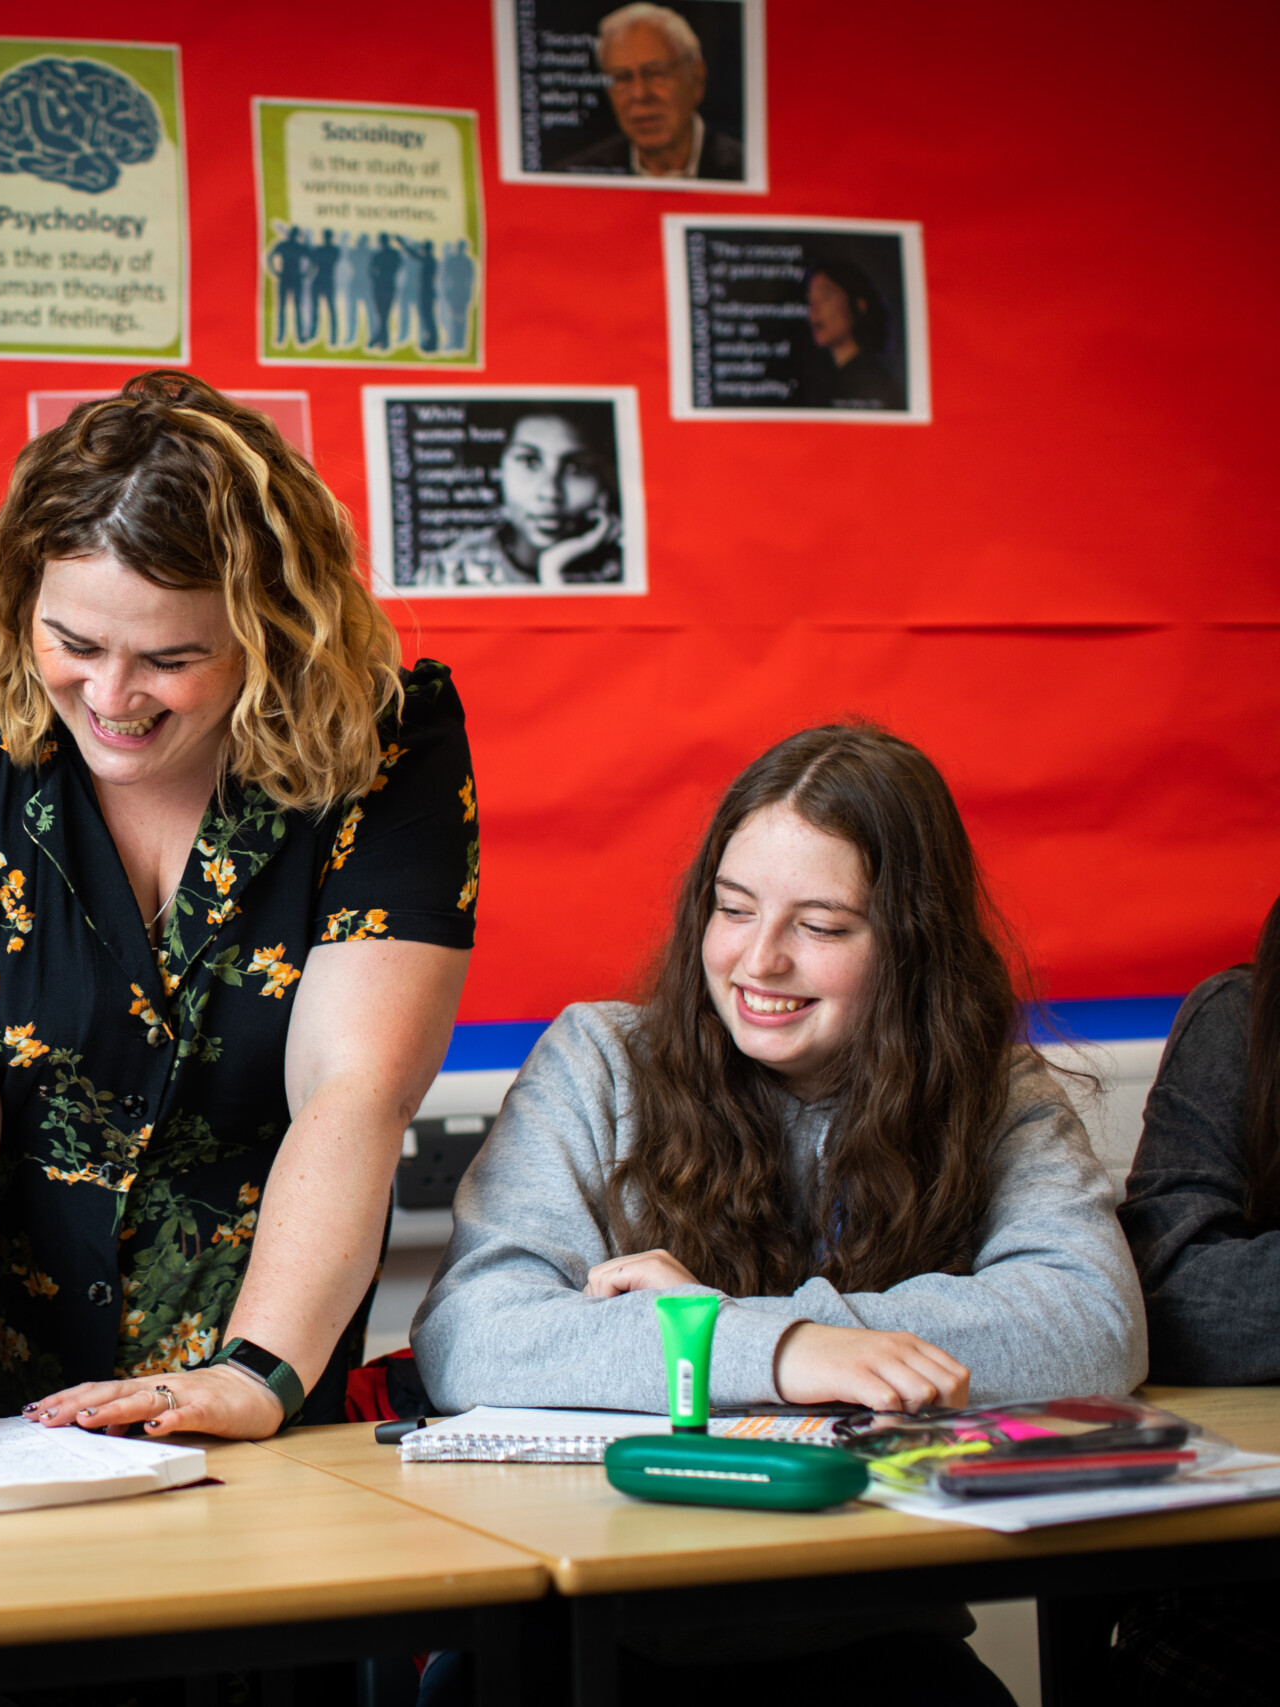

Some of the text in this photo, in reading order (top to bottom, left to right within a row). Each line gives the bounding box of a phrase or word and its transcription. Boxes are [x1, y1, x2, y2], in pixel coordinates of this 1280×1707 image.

[322, 121, 426, 150] Sociology
[329, 156, 361, 174] the
[365, 158, 416, 181] study
[420, 159, 440, 177] of
[302, 177, 371, 196] various
[316, 199, 351, 218] and
[19, 247, 53, 268] the
[58, 250, 121, 276] study
[126, 250, 154, 273] of
[61, 278, 166, 307] thoughts
[388, 404, 410, 479] QUOTES
[393, 482, 413, 584] SOCIOLOGY
